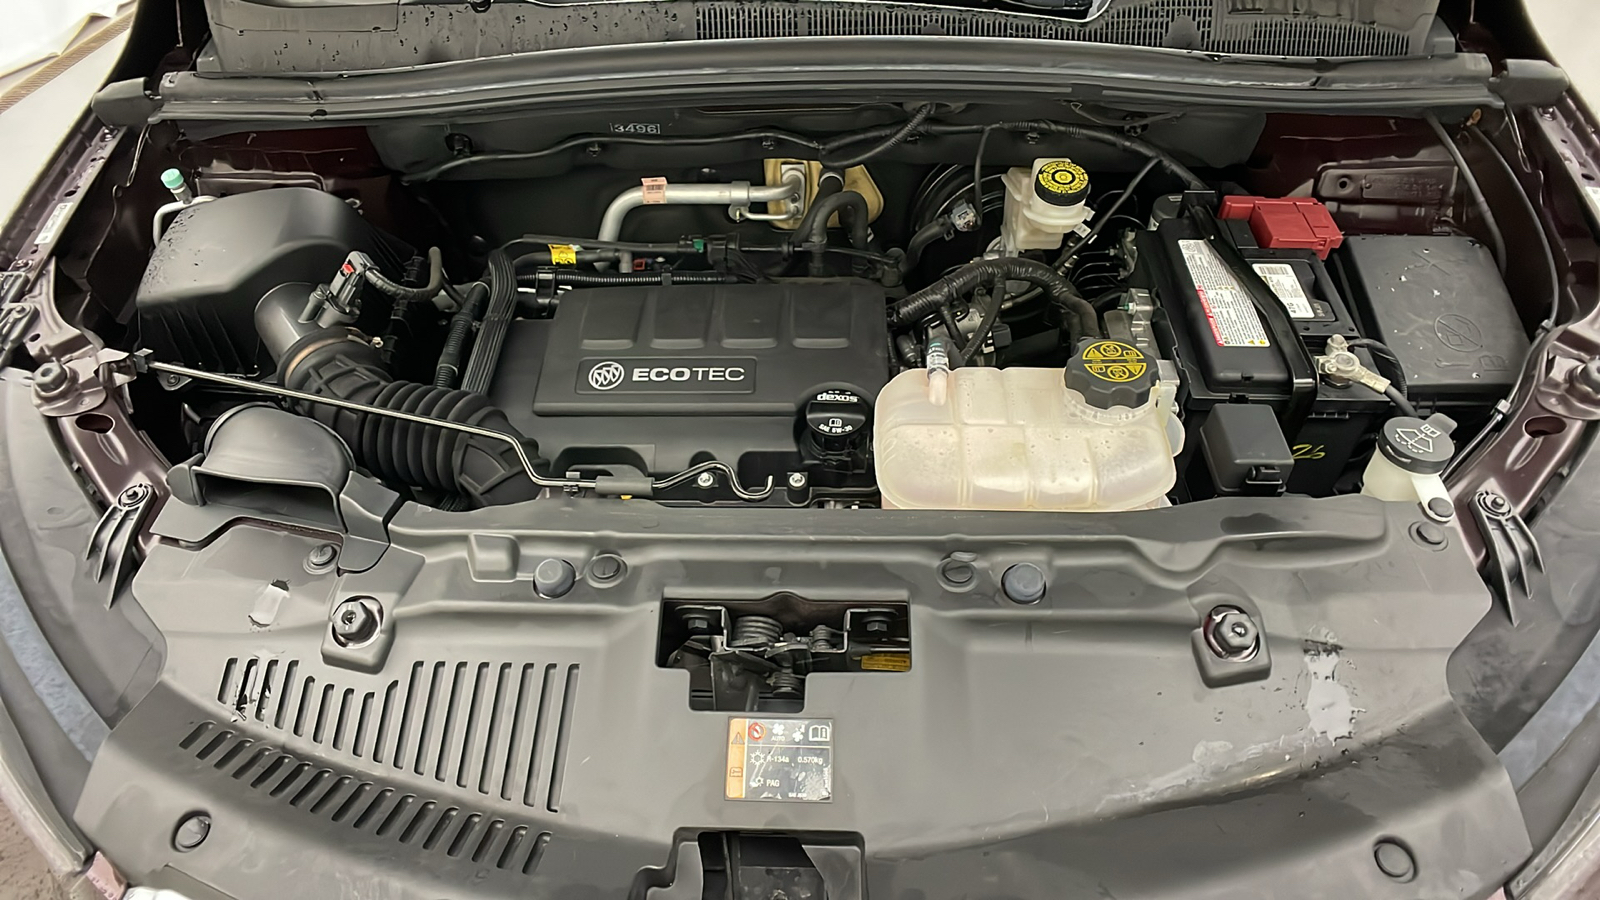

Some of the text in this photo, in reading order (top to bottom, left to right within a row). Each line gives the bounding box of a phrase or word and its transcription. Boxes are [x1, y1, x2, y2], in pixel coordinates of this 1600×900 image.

[614, 123, 657, 134] 3496
[632, 367, 745, 381] ECOTEC
[816, 392, 860, 403] dexos
[766, 779, 780, 787] PAG
